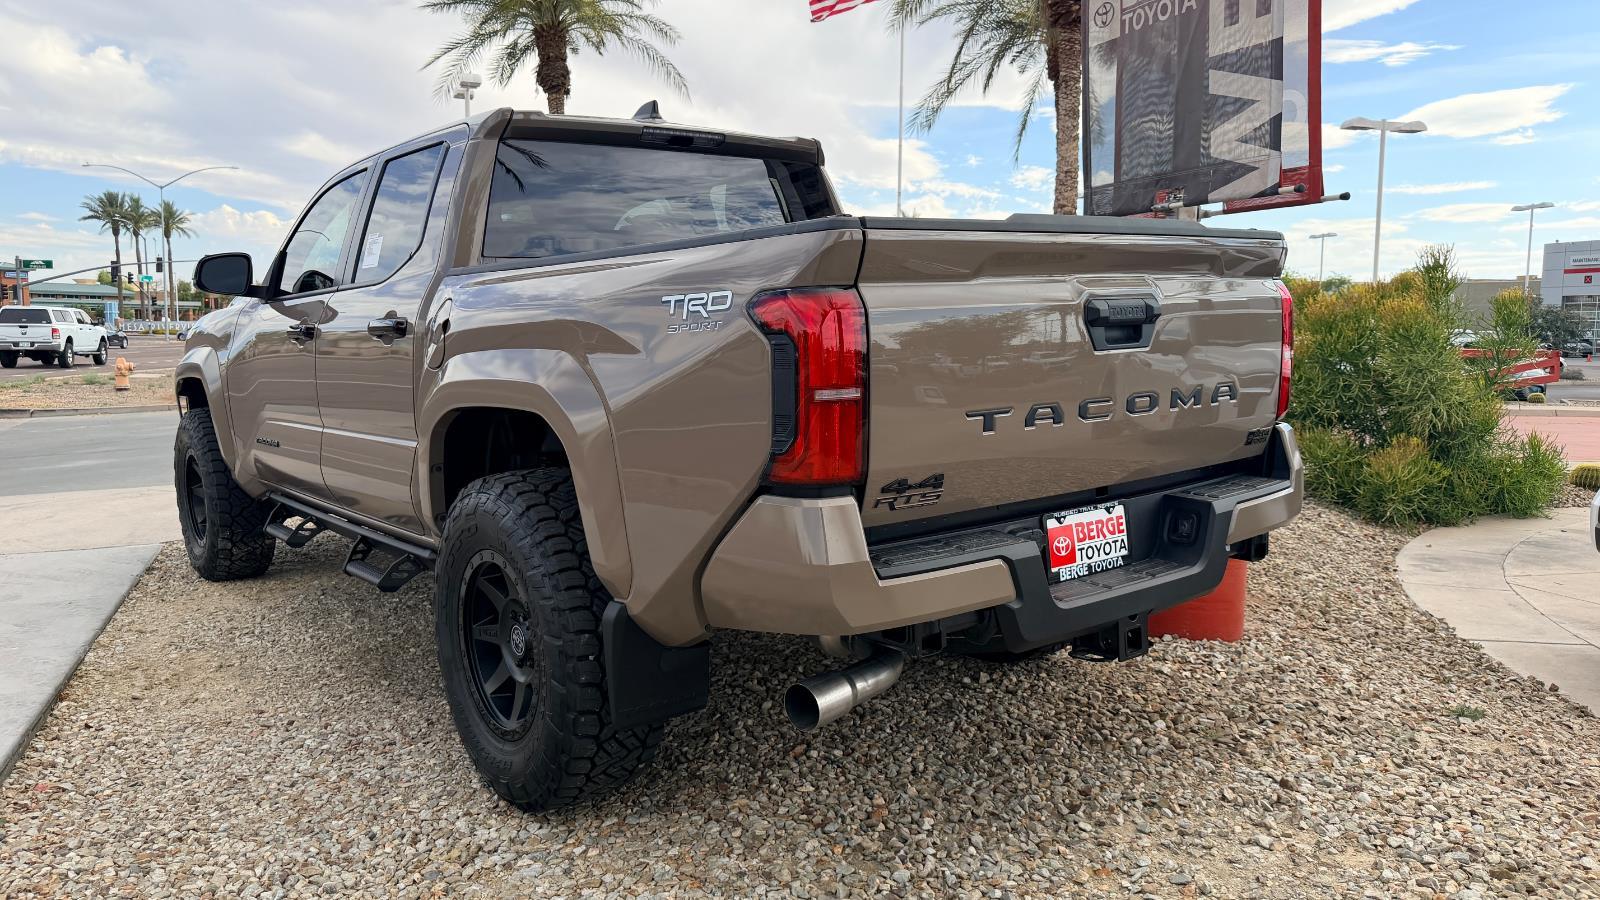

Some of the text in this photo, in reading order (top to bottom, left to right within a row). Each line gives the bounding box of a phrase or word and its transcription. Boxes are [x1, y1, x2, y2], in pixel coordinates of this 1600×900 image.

[661, 290, 733, 320] TRD
[1110, 306, 1145, 318] TOYOTA
[667, 321, 723, 334] SPORT
[965, 381, 1239, 436] TACOMA
[1075, 514, 1125, 544] BERGE
[1077, 538, 1128, 562] TOYOTA
[1060, 557, 1124, 582] BERGE TOYOTA
